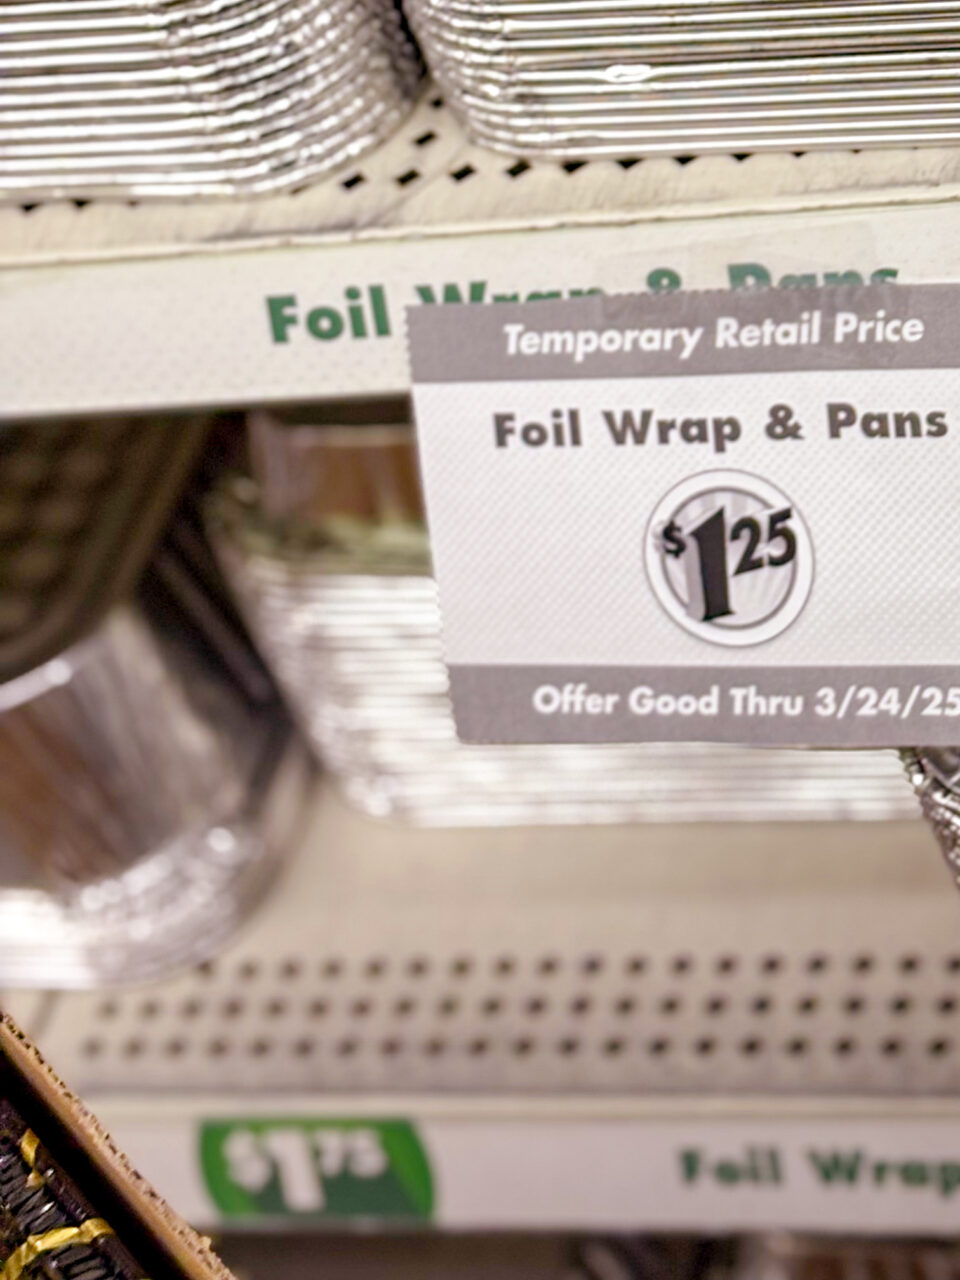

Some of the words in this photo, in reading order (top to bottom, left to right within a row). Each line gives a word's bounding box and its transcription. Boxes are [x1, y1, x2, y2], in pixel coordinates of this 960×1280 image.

[265, 284, 392, 345] Foil
[504, 323, 704, 363] Temporary
[715, 310, 821, 350] Retail
[833, 310, 926, 343] Price
[493, 408, 583, 449] Foil
[601, 408, 742, 453] Wrap
[764, 403, 805, 441] &
[827, 402, 949, 440] Pans
[532, 682, 619, 716] Offer
[628, 684, 720, 717] Good
[729, 685, 804, 717] Thru
